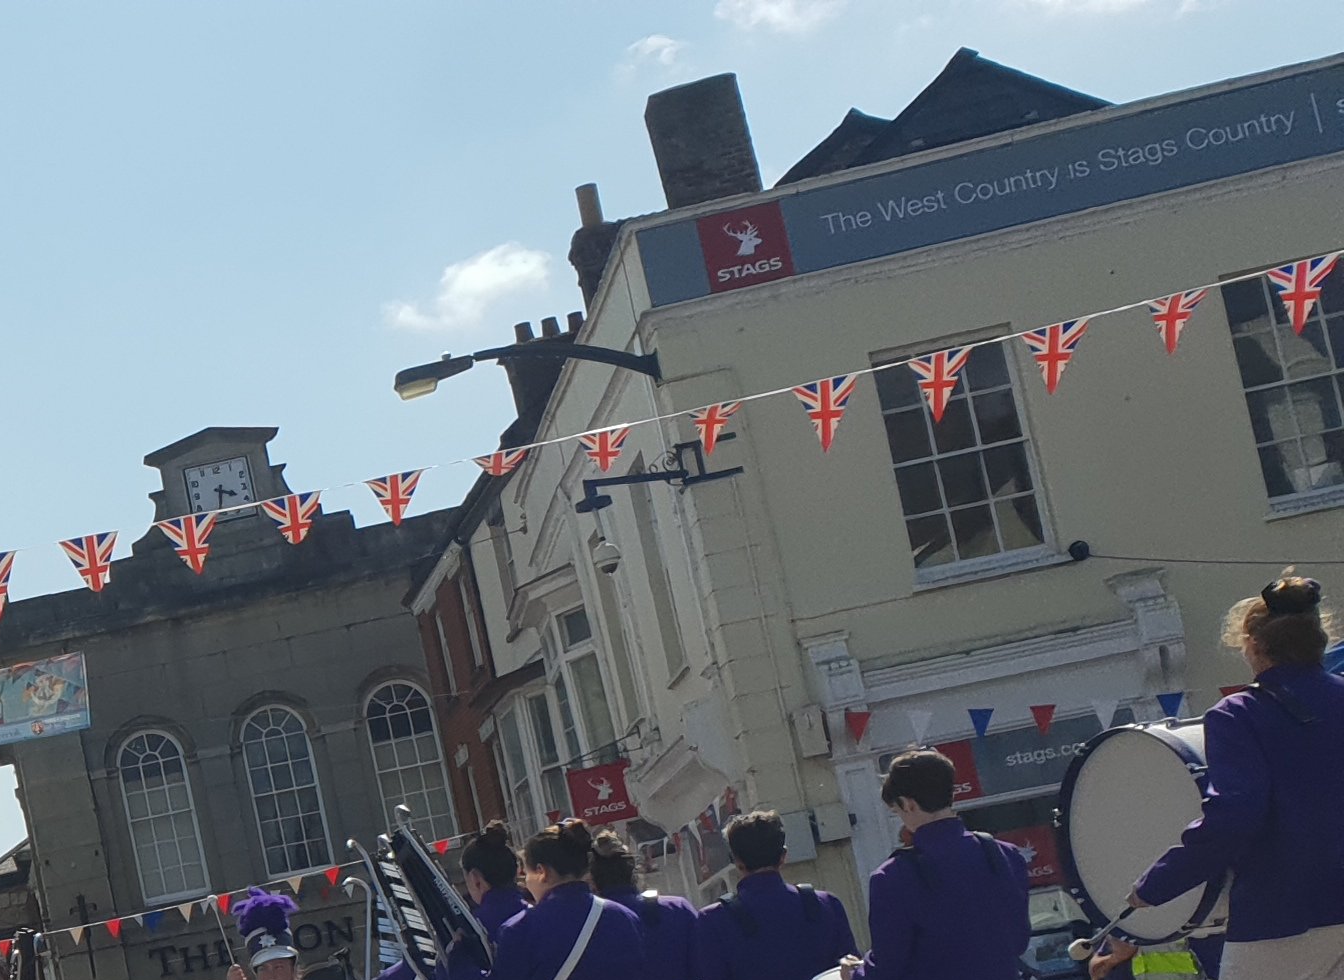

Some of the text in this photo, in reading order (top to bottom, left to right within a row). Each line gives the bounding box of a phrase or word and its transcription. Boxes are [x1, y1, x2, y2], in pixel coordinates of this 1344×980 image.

[820, 110, 1295, 235] The West Country is Stags Country
[717, 256, 783, 283] STAGS
[1006, 741, 1086, 767] stags.co
[584, 801, 627, 817] STAGS
[148, 937, 235, 978] THE
